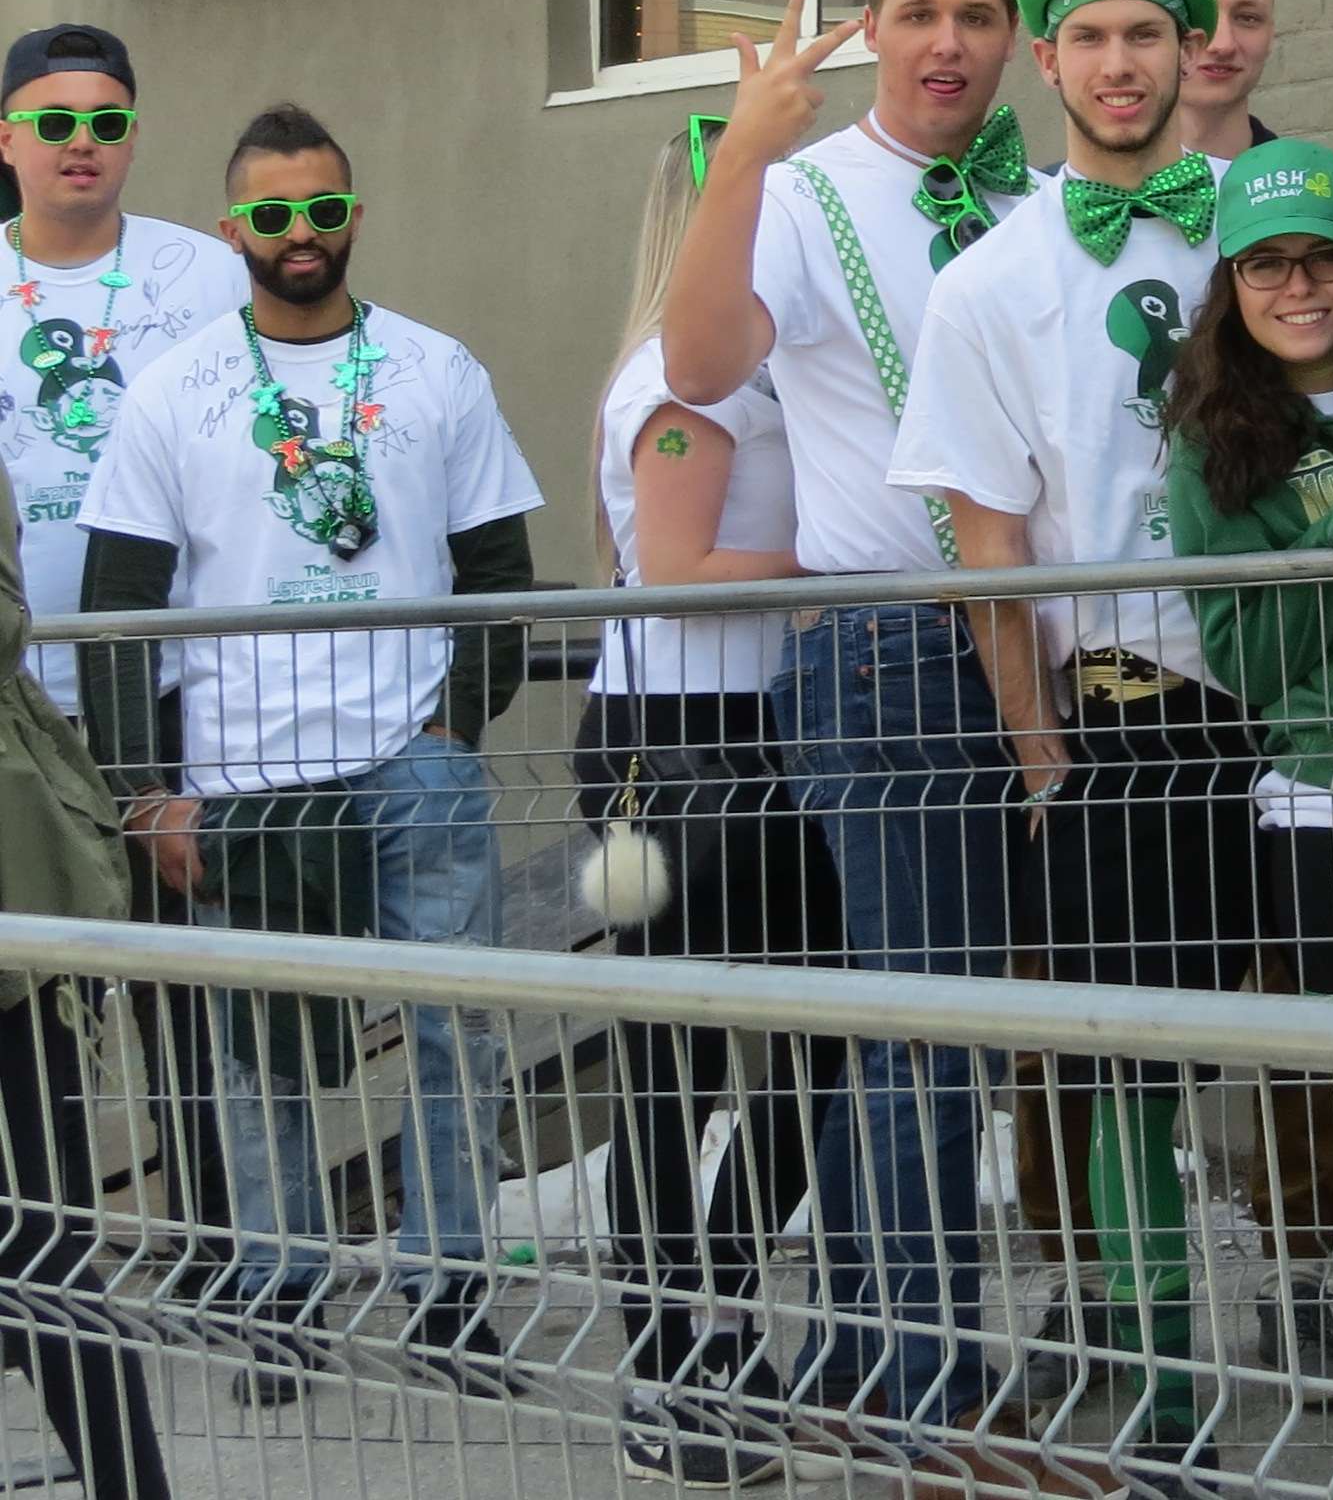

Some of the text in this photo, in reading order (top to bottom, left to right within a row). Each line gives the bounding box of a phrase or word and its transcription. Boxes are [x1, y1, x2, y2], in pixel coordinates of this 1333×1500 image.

[1244, 170, 1304, 196] IRISH
[63, 470, 90, 483] The
[304, 563, 331, 577] The
[268, 570, 380, 598] Leprechaun
